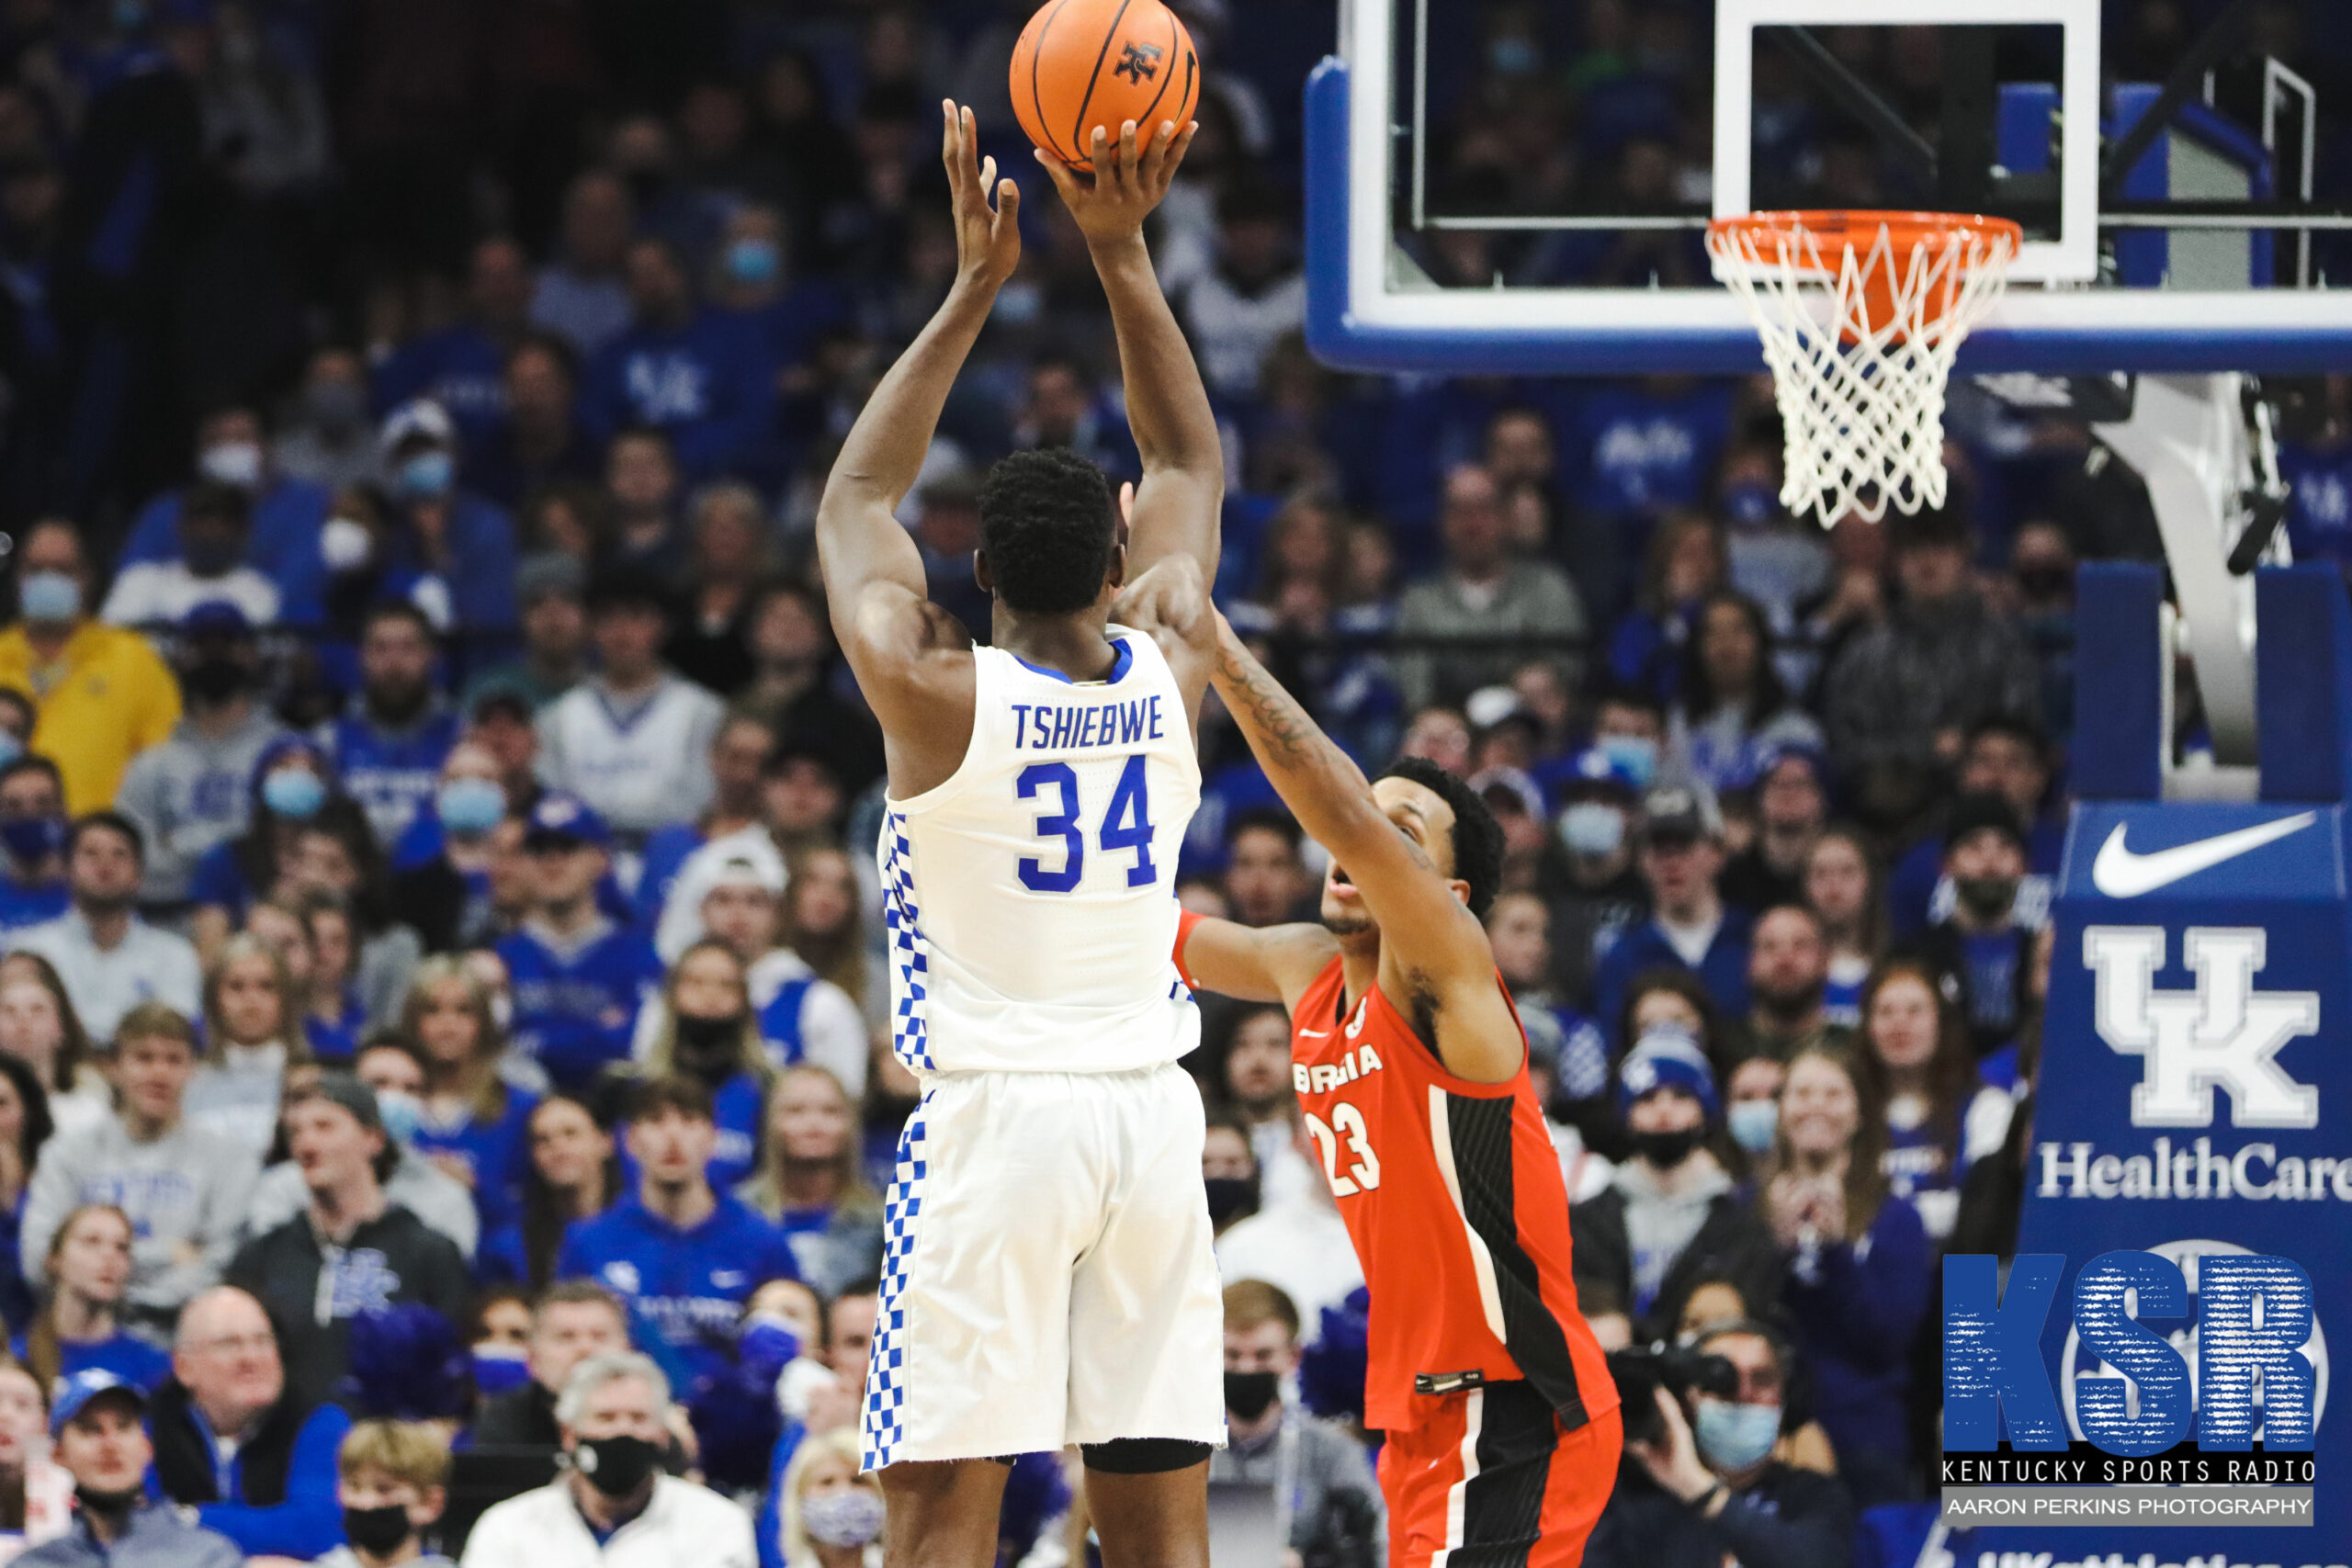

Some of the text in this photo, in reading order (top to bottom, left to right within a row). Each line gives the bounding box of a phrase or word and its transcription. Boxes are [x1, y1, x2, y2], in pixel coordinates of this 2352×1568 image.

[1113, 40, 1163, 86] UK
[1012, 694, 1164, 749] TSHIEBWE
[1014, 752, 1158, 894] 34
[2083, 924, 2321, 1130] UK
[1304, 1102, 1381, 1197] 23
